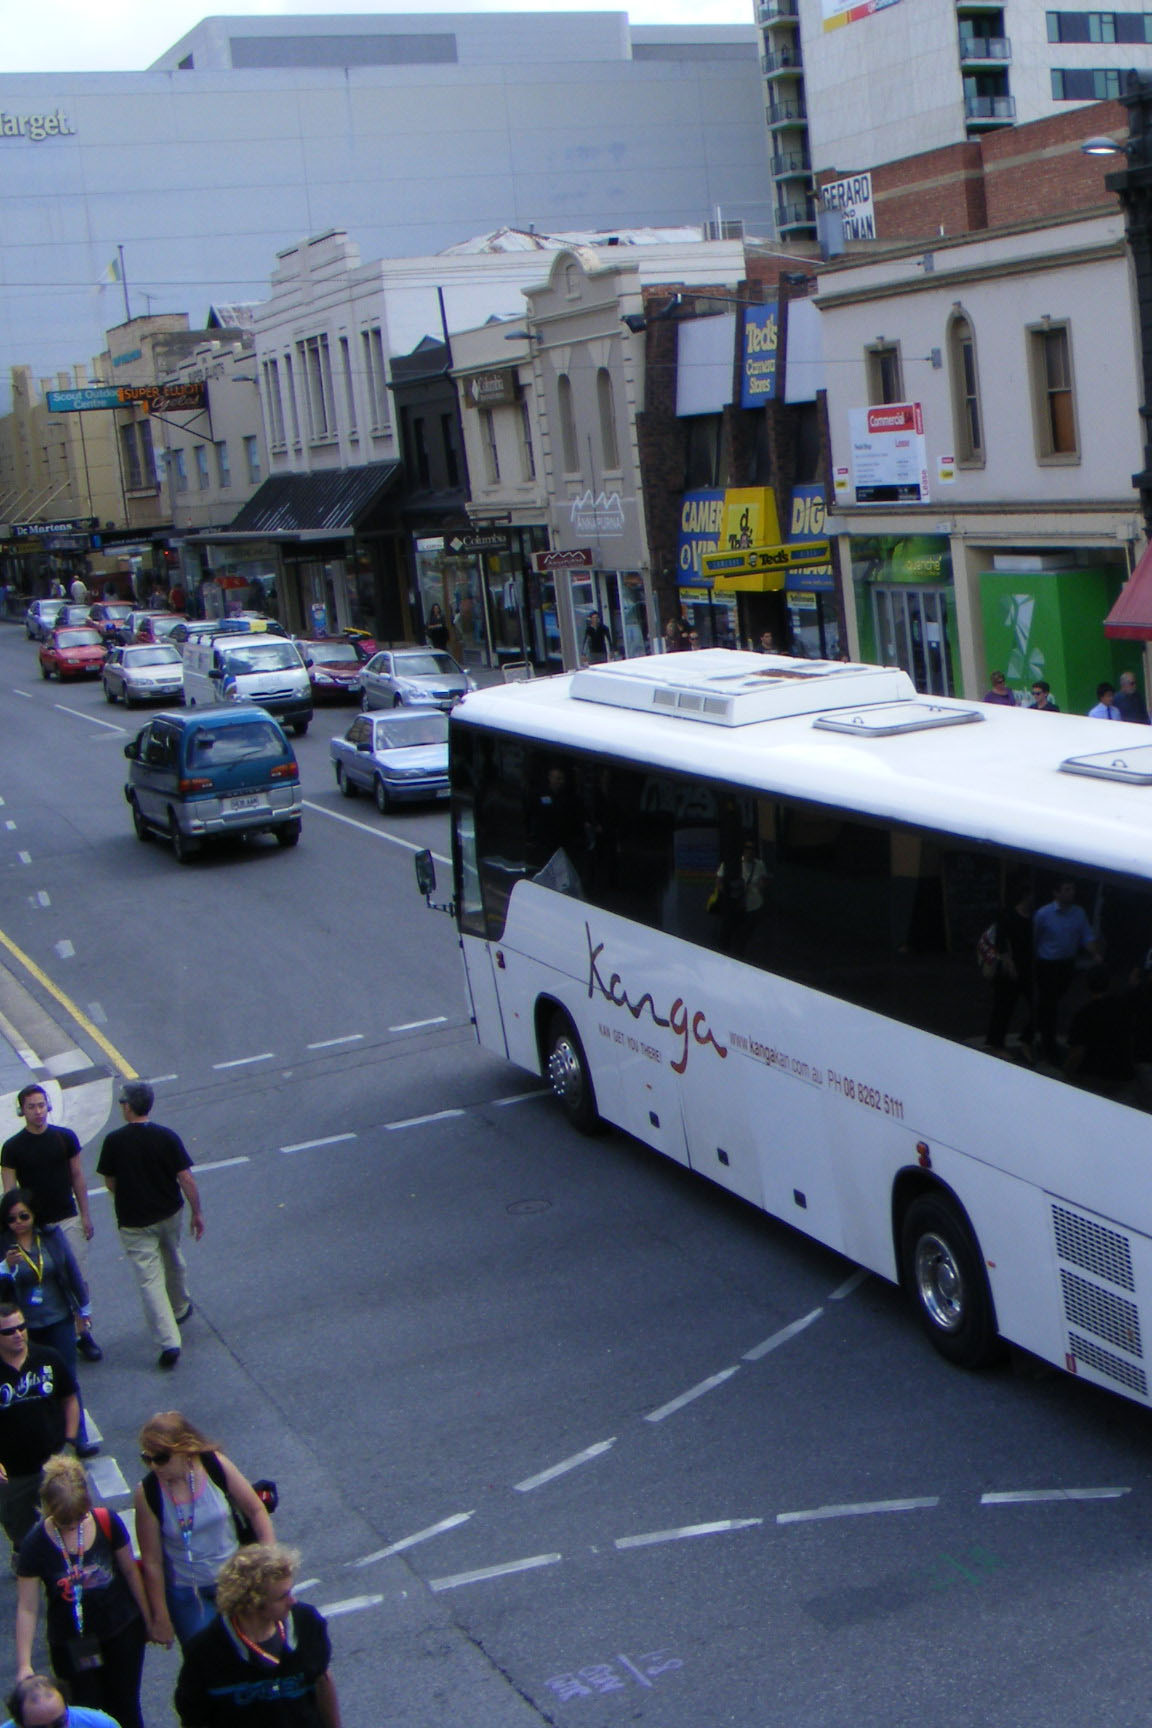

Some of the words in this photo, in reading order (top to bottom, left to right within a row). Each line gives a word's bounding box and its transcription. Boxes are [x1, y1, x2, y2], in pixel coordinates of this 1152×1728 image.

[823, 176, 870, 210] GERARD
[746, 313, 778, 354] Ted's
[746, 359, 776, 375] Camera
[125, 388, 159, 400] SUPER
[749, 376, 771, 394] Stores
[54, 392, 83, 402] Scout
[85, 388, 118, 399] Outdo
[74, 399, 107, 409] Centre
[869, 411, 905, 427] Commercial
[921, 469, 929, 496] Lease
[682, 500, 724, 533] CAMER
[29, 523, 73, 535] Martens
[463, 534, 507, 547] Columbia
[759, 549, 789, 565] Ted's
[585, 921, 728, 1075] Kanga
[599, 1023, 611, 1039] KAN
[613, 1029, 625, 1045] GET
[627, 1035, 639, 1053] YOU
[729, 1031, 823, 1085] www.kangakan.com.au
[828, 1068, 842, 1093] PH
[843, 1076, 856, 1100] 08
[858, 1082, 882, 1111] 8262
[884, 1093, 905, 1121] 5111
